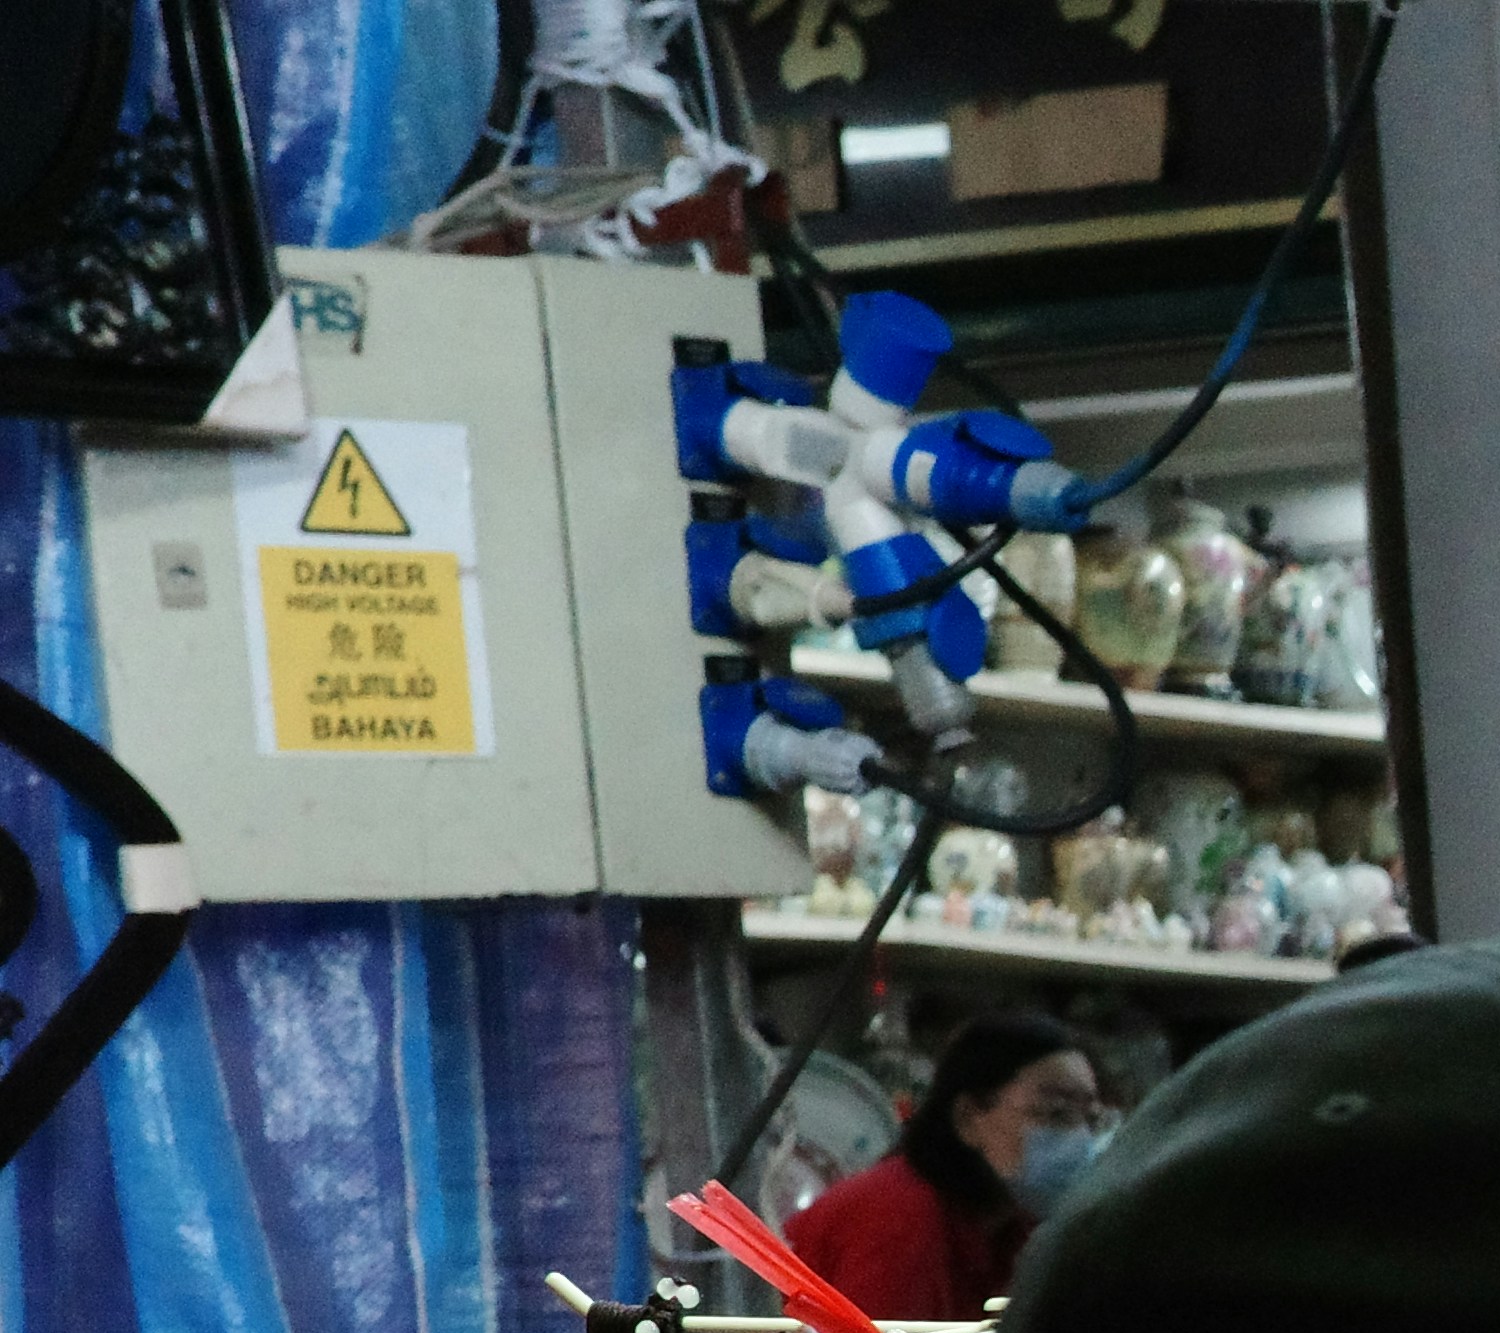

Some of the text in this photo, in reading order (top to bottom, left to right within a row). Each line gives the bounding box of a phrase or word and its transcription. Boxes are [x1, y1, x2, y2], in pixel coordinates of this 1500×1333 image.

[294, 558, 426, 588] DANGER
[285, 592, 439, 615] HIGH VOLTAGE
[311, 713, 436, 742] BAHAYA
